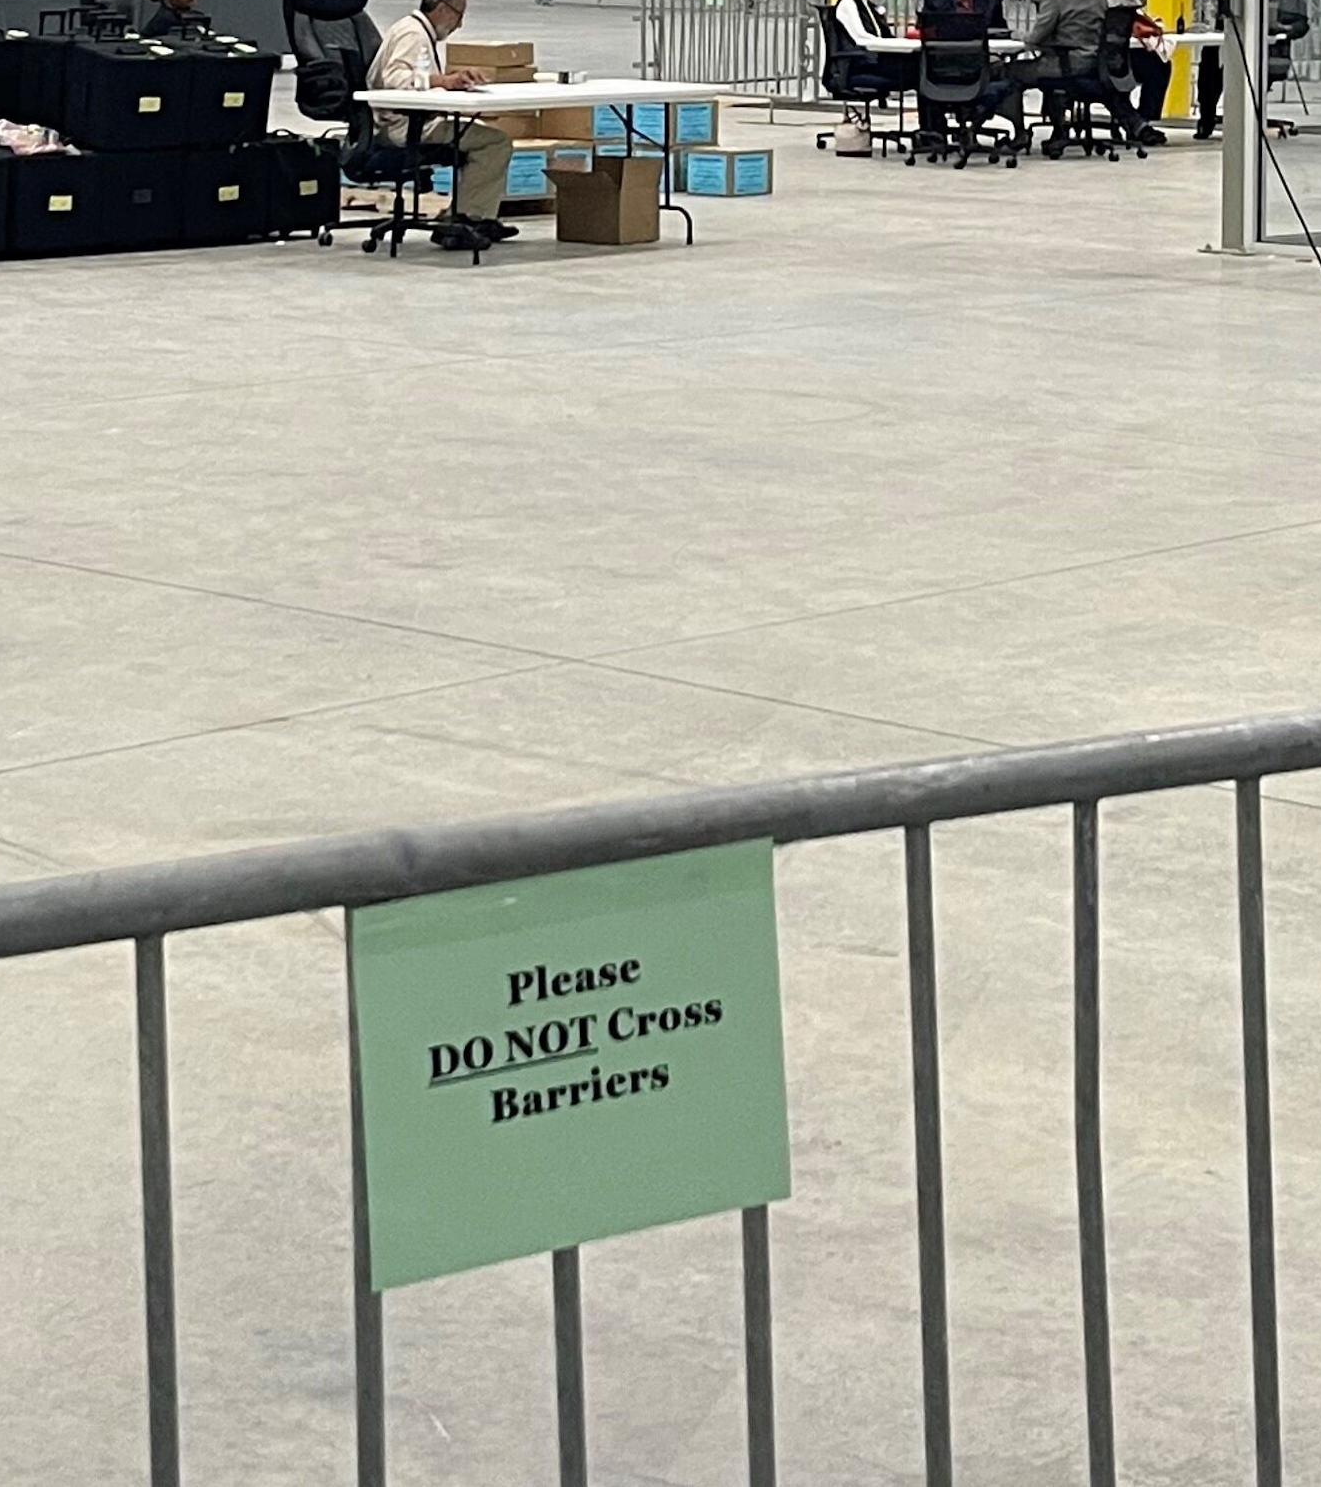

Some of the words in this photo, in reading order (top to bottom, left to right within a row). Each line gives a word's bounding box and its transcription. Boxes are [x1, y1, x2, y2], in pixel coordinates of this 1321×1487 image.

[507, 958, 641, 1007] Please
[428, 1035, 494, 1081] DO
[504, 1014, 598, 1063] NOT
[607, 998, 723, 1042] Cross
[491, 1063, 670, 1124] Barriers
